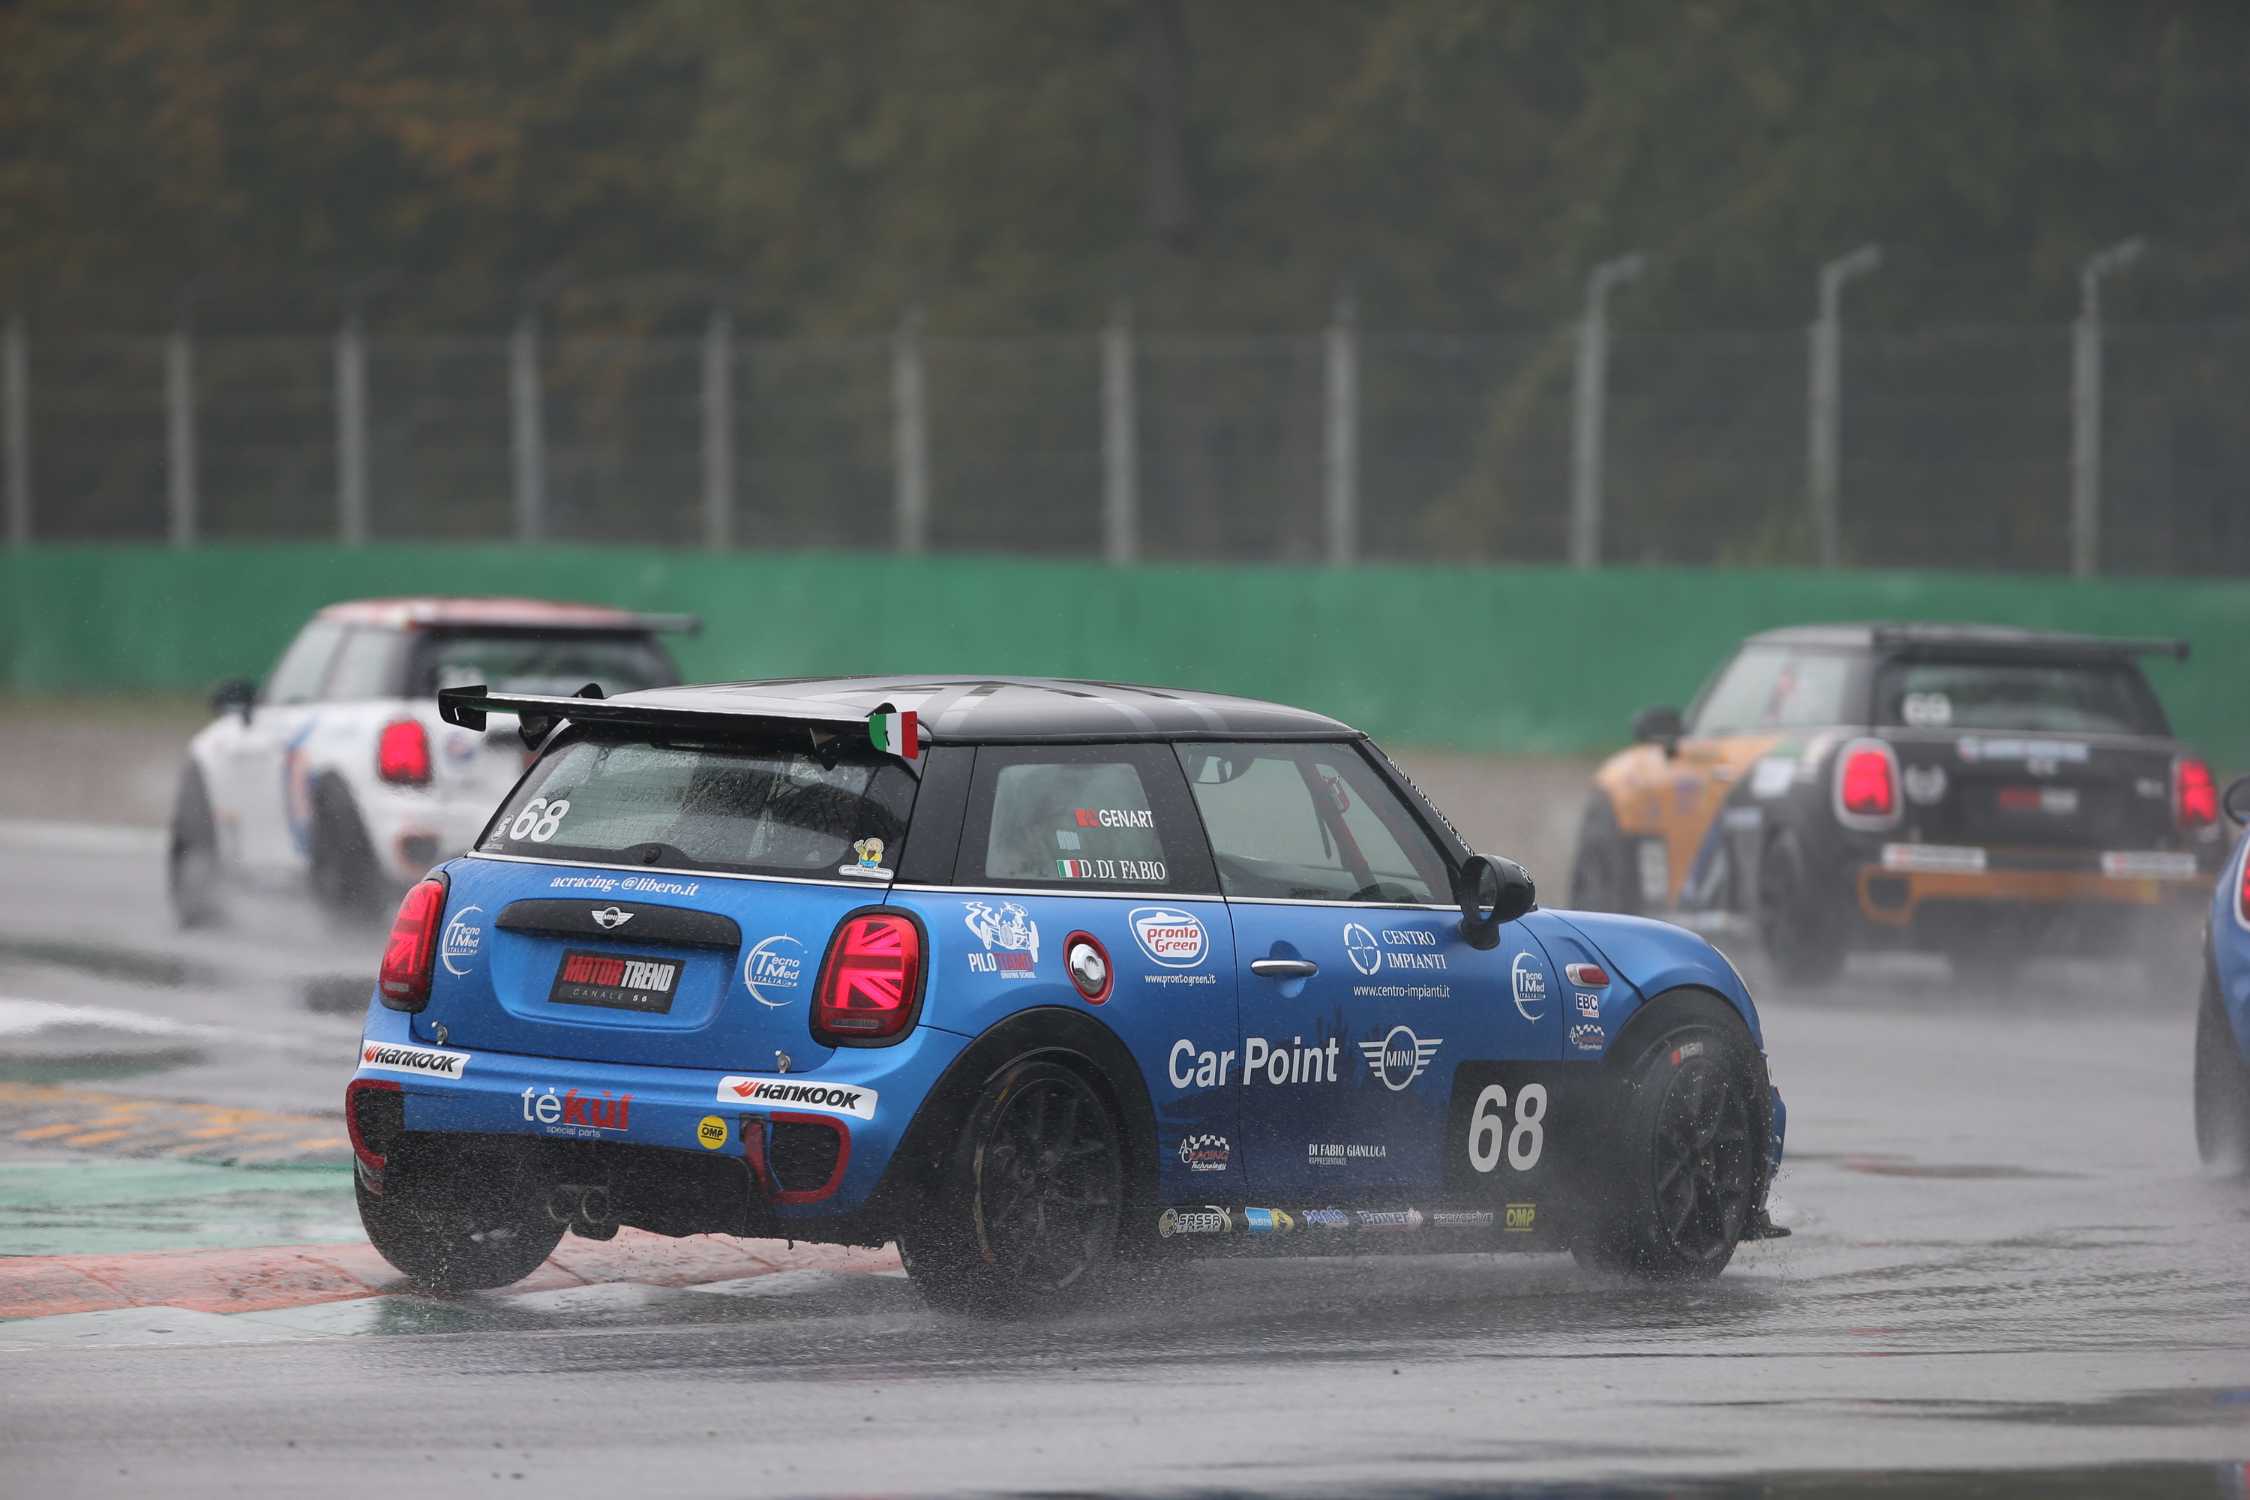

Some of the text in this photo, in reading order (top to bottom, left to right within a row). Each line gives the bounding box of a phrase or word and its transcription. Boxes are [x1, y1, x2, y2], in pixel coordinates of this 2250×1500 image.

[509, 797, 570, 843] 68
[1098, 809, 1154, 828] GENART
[1118, 860, 1166, 880] FABIO
[1146, 927, 1198, 944] pronto
[1382, 929, 1437, 946] CENTRO
[1154, 939, 1198, 953] Green
[1387, 952, 1448, 970] IMPIANTI
[1144, 973, 1217, 988] www.prontogreen.it
[1353, 984, 1451, 1001] www.centro-impianti.it
[1577, 994, 1599, 1010] EBC
[1168, 1035, 1340, 1089] Car Point
[1385, 1049, 1414, 1068] MINI
[546, 1126, 601, 1138] special parts
[701, 1126, 724, 1139] OMP
[1468, 1083, 1548, 1173] 68
[1308, 1143, 1387, 1158] DI FABIO GIANLUCA
[1177, 1213, 1222, 1226] SASSA
[1505, 1207, 1536, 1228] OMP
